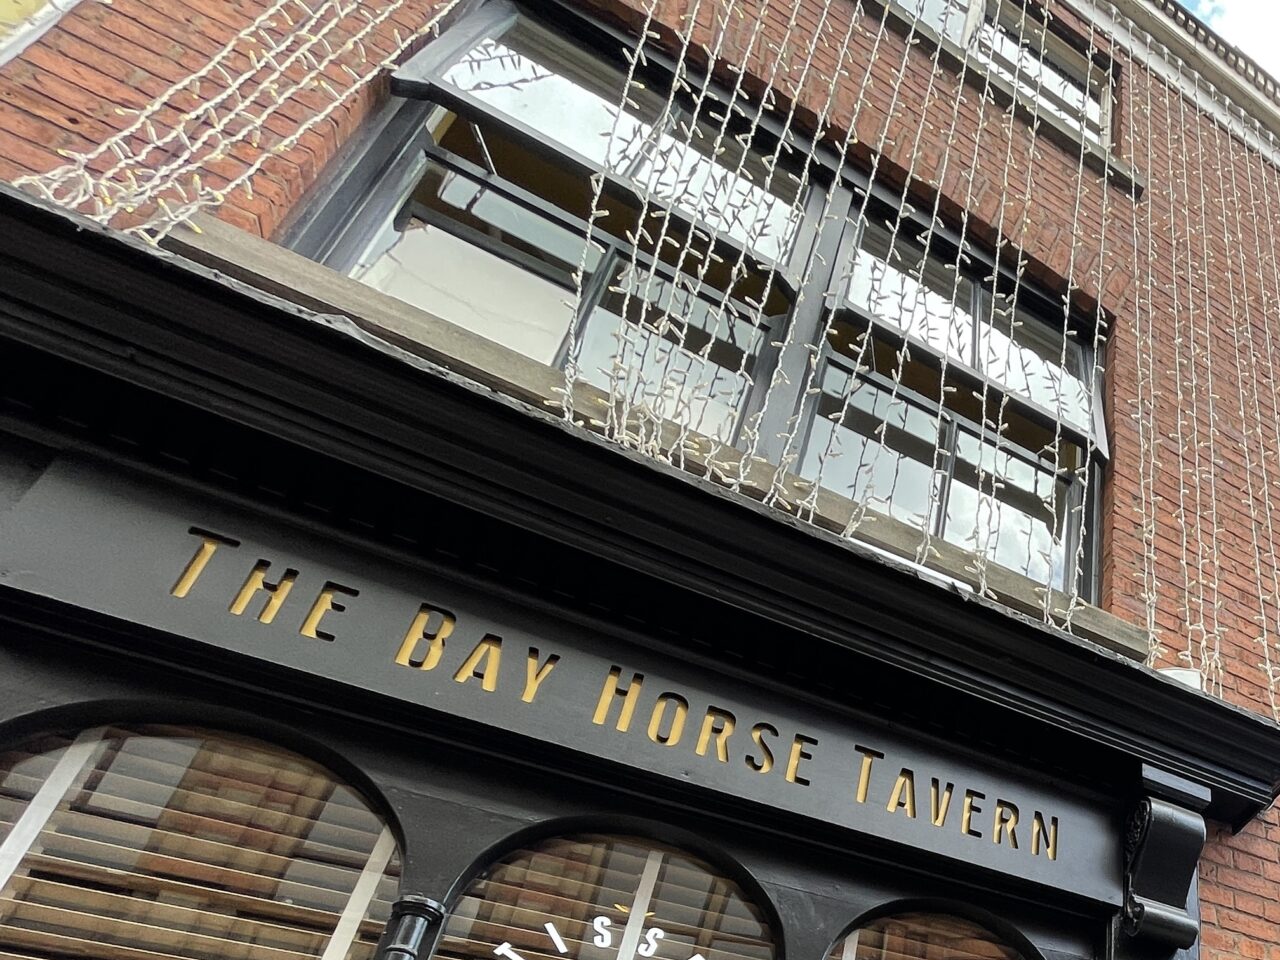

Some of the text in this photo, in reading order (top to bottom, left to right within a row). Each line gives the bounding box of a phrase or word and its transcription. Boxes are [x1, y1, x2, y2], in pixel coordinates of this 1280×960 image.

[170, 526, 1059, 861] THE BAY HORSE TAVERN
